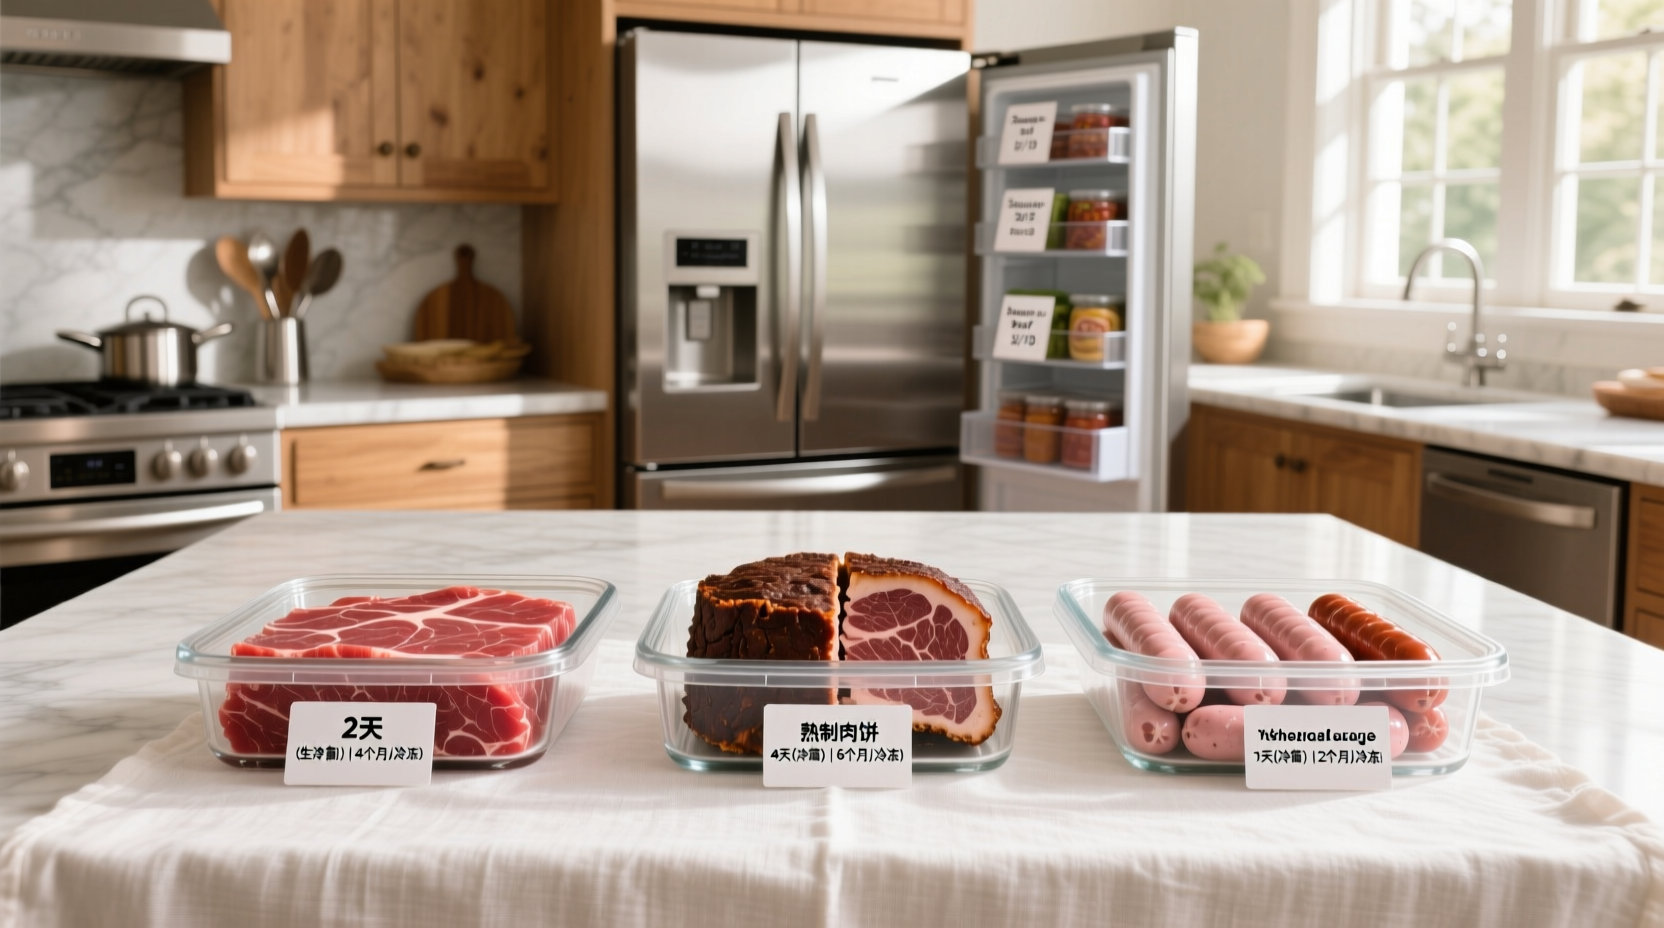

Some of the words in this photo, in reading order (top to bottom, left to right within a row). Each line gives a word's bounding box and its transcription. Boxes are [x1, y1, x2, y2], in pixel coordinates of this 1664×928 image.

[341, 716, 383, 740] 2天
[800, 721, 879, 743] 熟制肉饼
